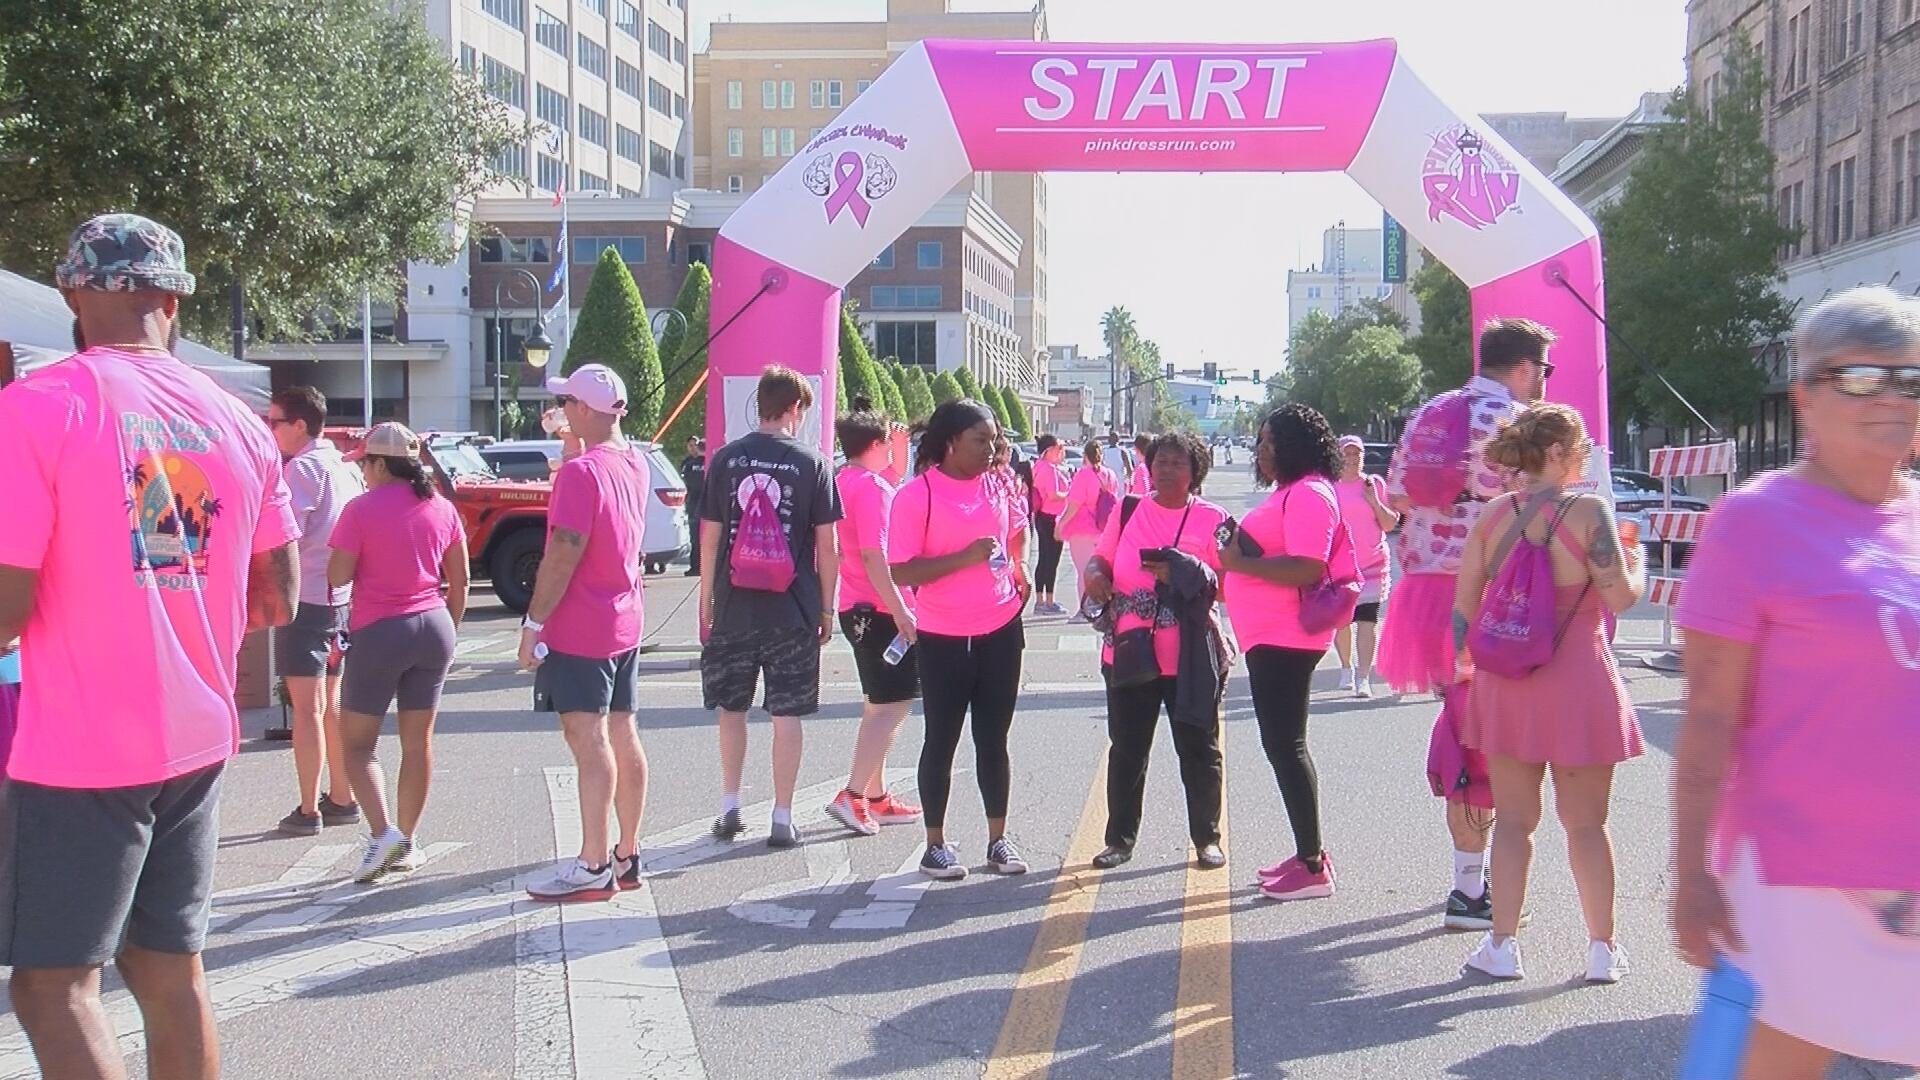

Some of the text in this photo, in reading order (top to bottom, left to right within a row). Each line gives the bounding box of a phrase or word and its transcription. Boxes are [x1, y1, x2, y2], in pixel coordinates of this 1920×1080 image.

[1023, 57, 1308, 121] START
[1084, 137, 1236, 152] pinkdressrun.com
[1422, 173, 1520, 230] RUN
